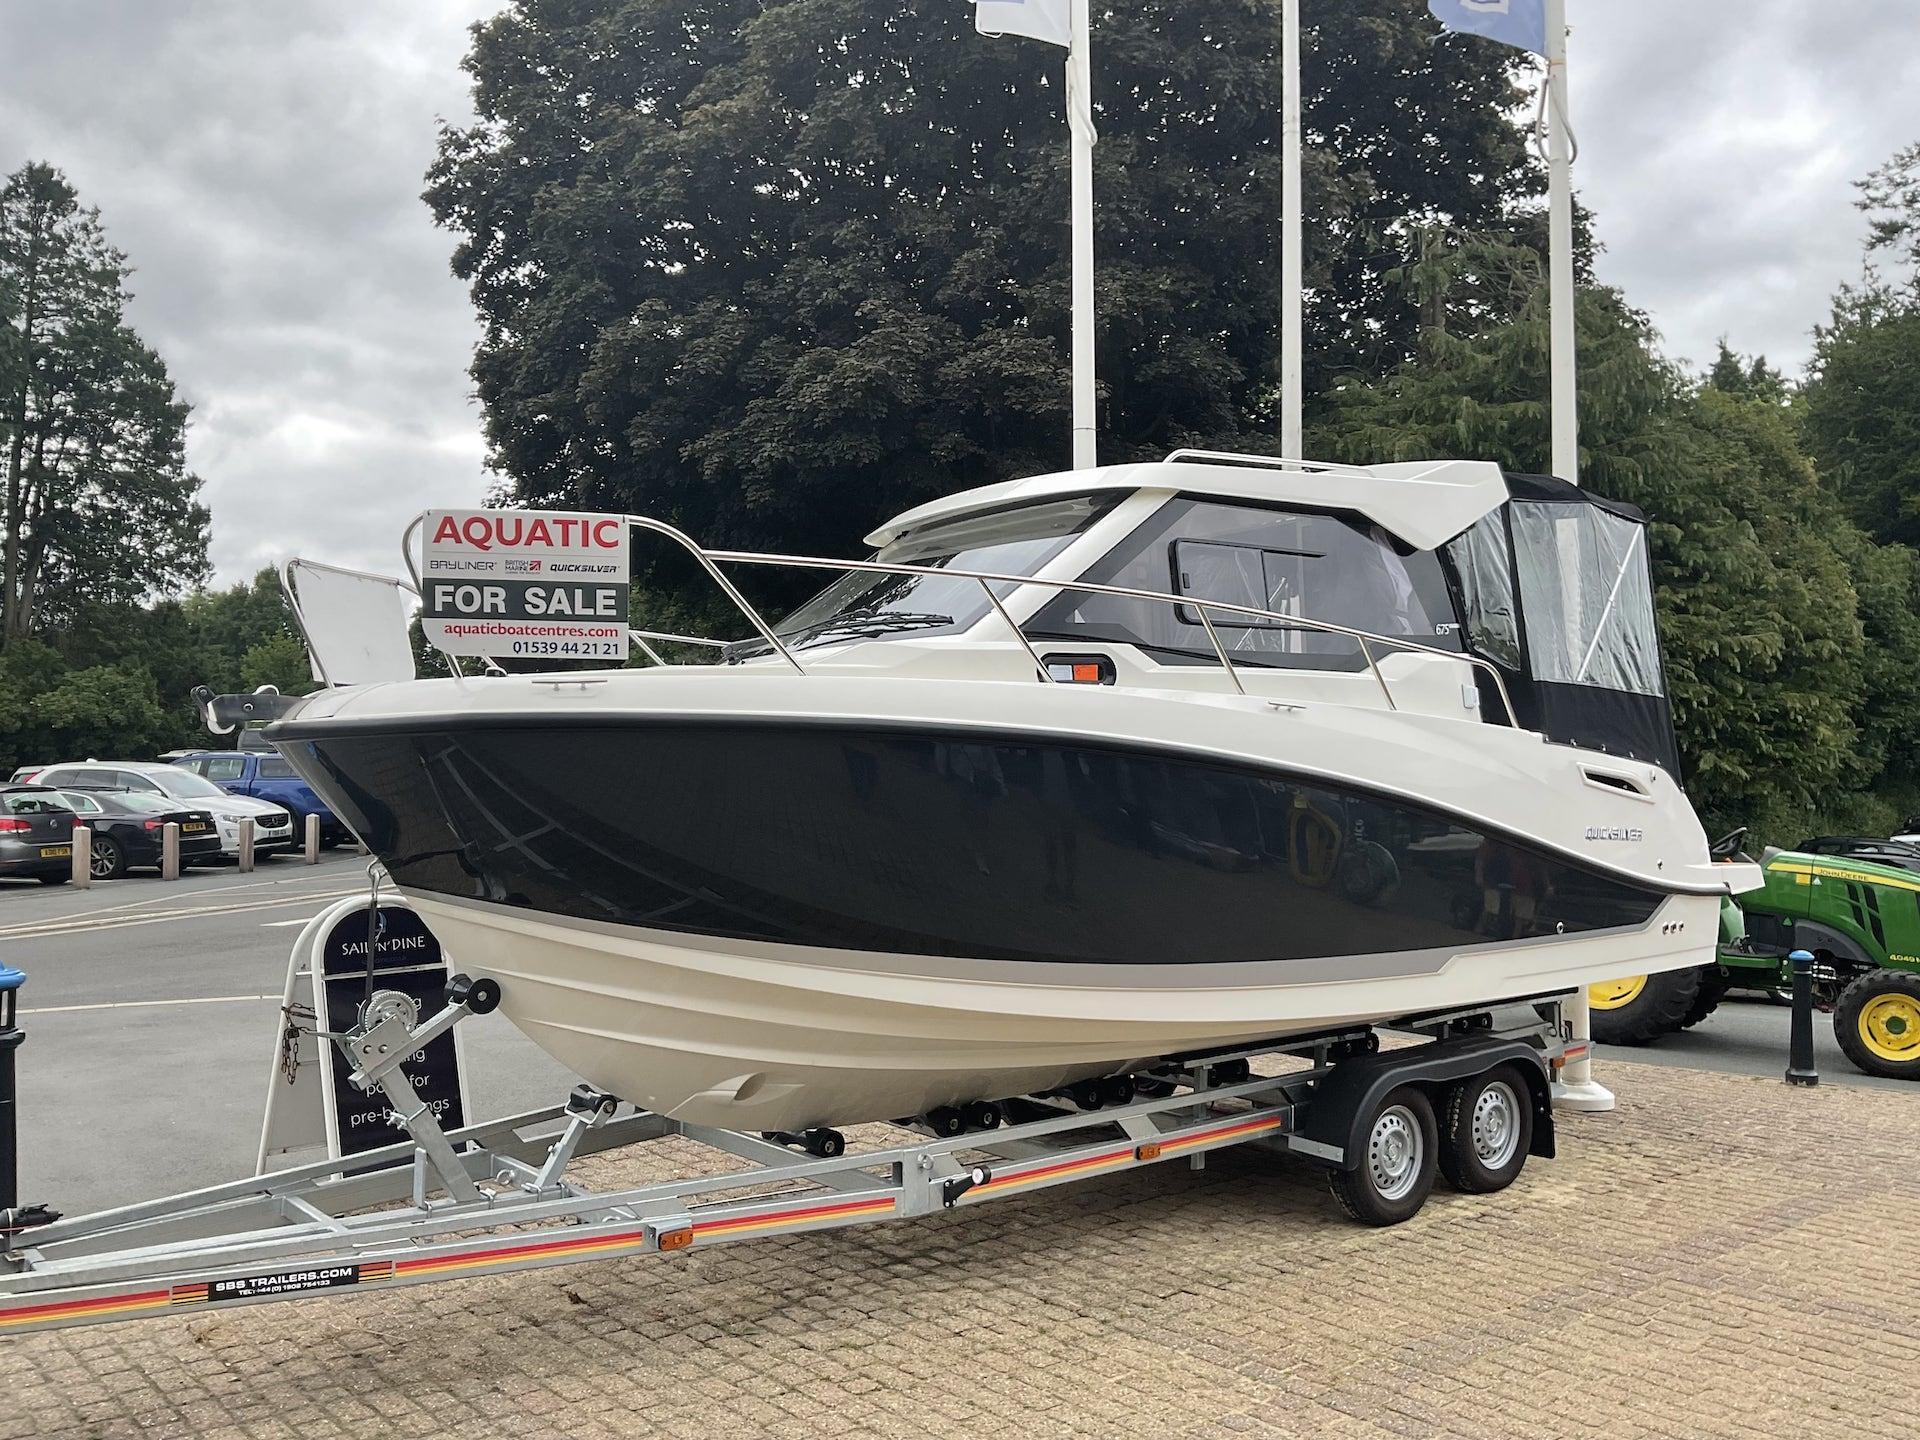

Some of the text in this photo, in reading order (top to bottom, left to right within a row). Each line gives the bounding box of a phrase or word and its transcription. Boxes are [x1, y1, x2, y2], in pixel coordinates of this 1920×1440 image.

[432, 516, 619, 551] AQUATIC
[430, 560, 495, 571] BAYLINER
[550, 563, 617, 574] QUICKSILVER
[434, 584, 617, 616] FOR SALE
[444, 622, 619, 638] aquaticboatcentres.com
[1435, 623, 1450, 636] 675
[513, 641, 619, 656] 01539 44 21 21
[409, 1074, 430, 1088] for
[215, 1268, 352, 1292] SBS TRAILERS.COM
